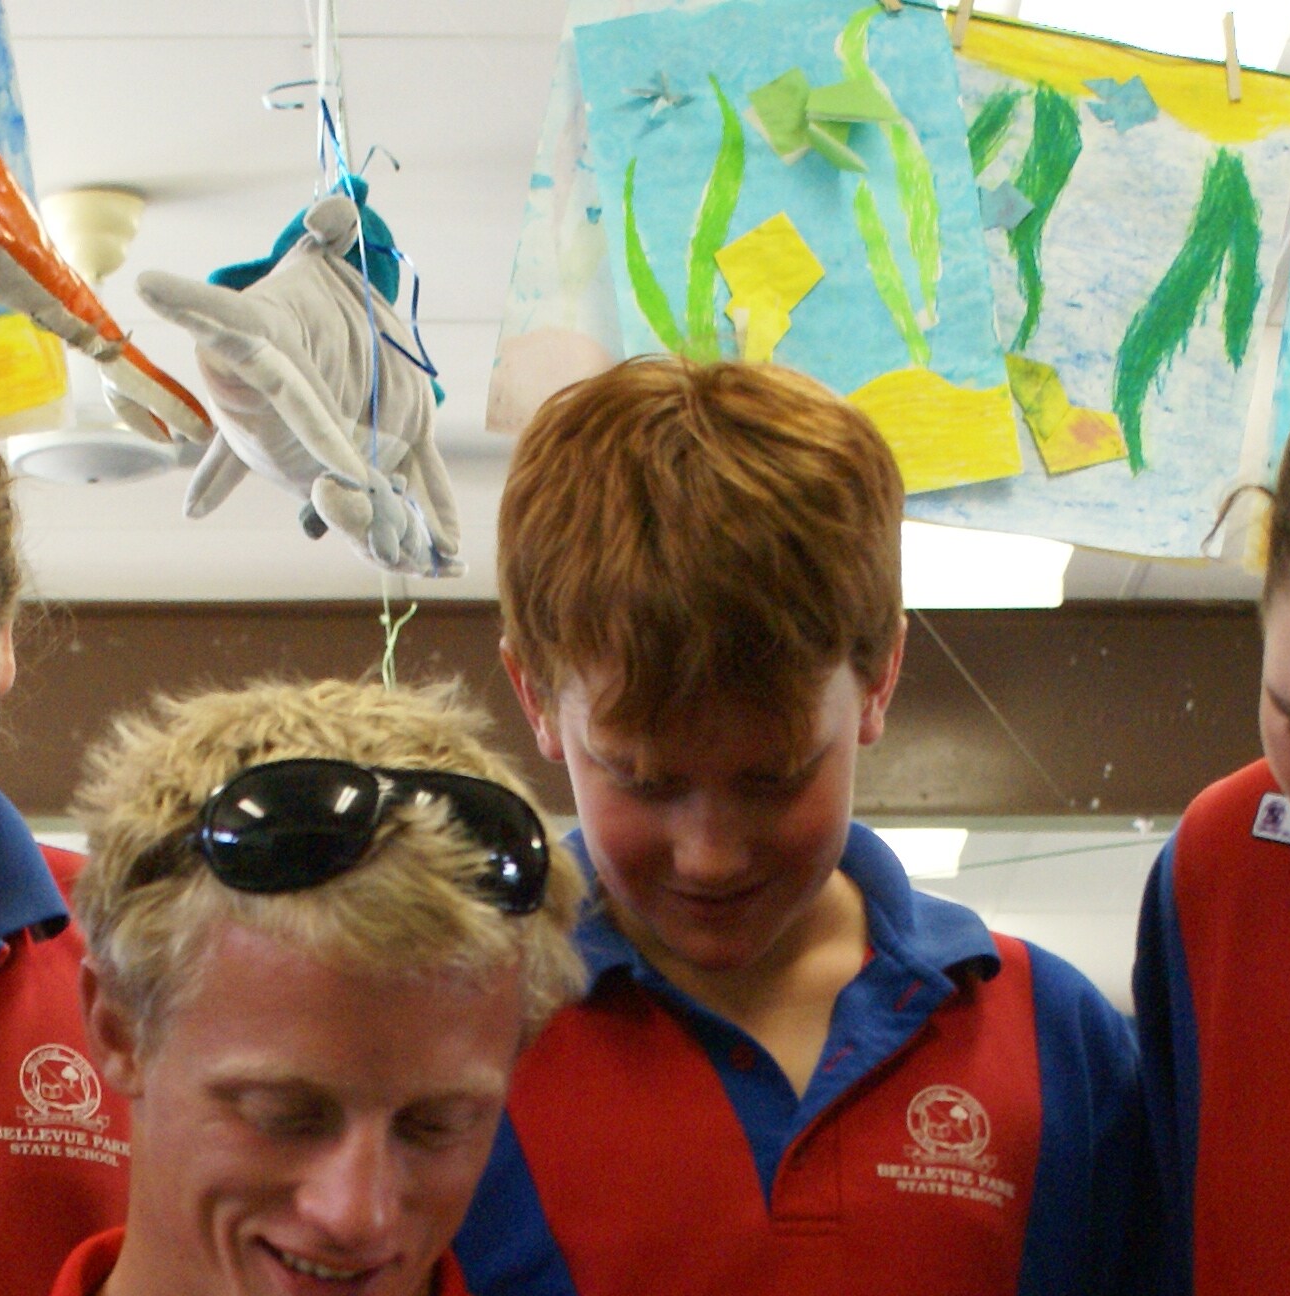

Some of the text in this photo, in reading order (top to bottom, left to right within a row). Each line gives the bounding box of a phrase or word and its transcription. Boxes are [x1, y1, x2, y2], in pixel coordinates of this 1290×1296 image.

[11, 1144, 118, 1166] STATE SCHOOL
[94, 1136, 130, 1156] PARK
